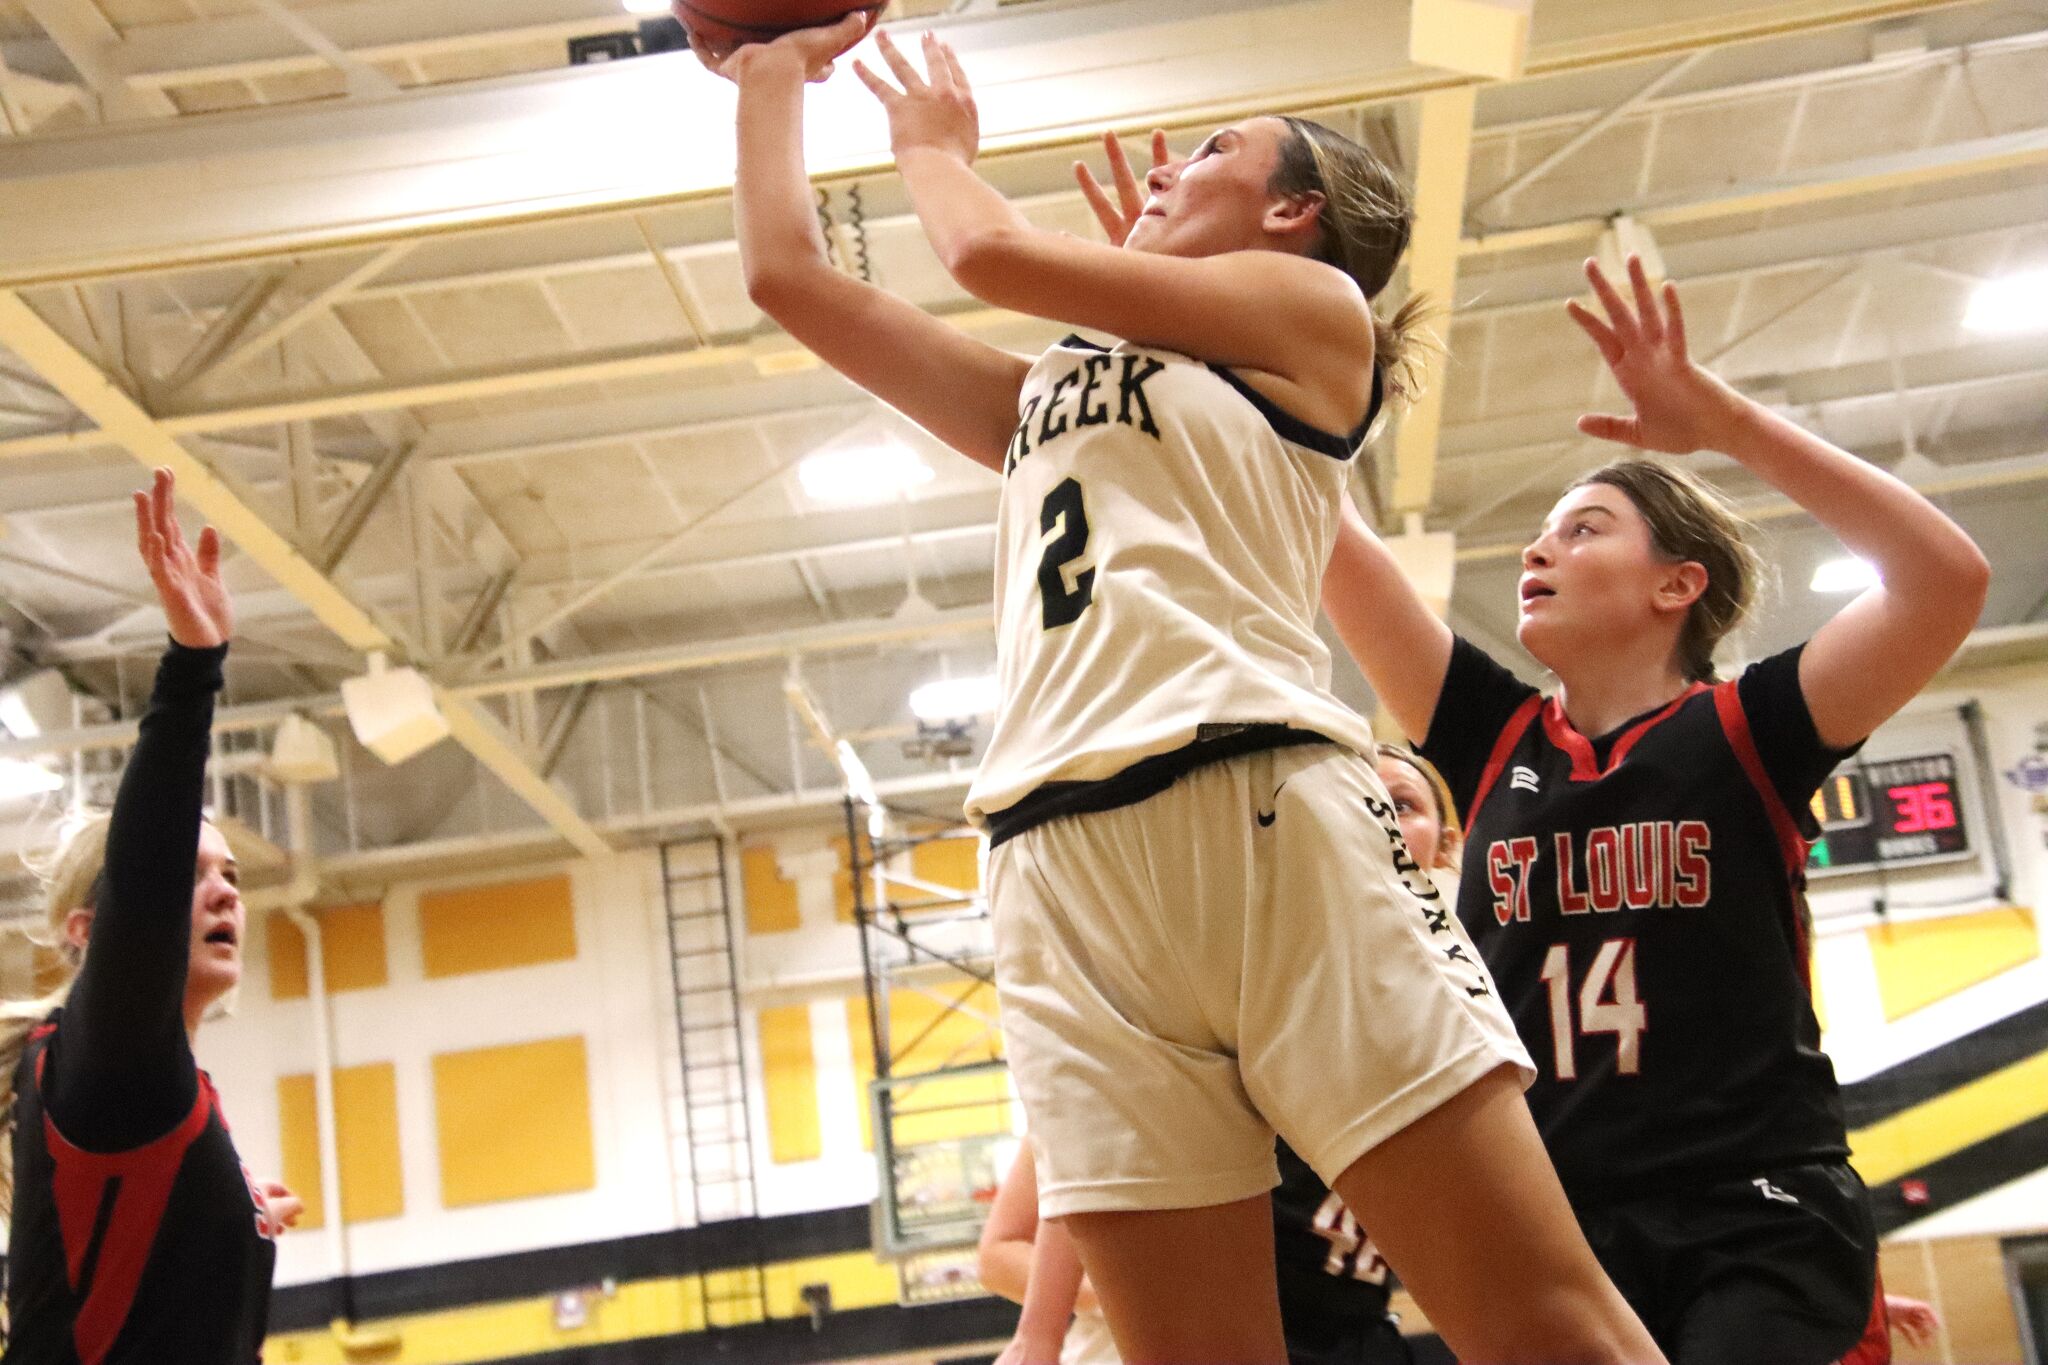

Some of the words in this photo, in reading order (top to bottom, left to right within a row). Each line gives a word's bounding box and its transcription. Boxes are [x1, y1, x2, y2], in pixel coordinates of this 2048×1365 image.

[1007, 353, 1165, 480] REEK
[1037, 477, 1096, 631] 2
[1888, 782, 1957, 833] 36
[1487, 836, 1538, 927] ST
[1554, 820, 1711, 916] LOUIS
[1540, 936, 1648, 1082] 14
